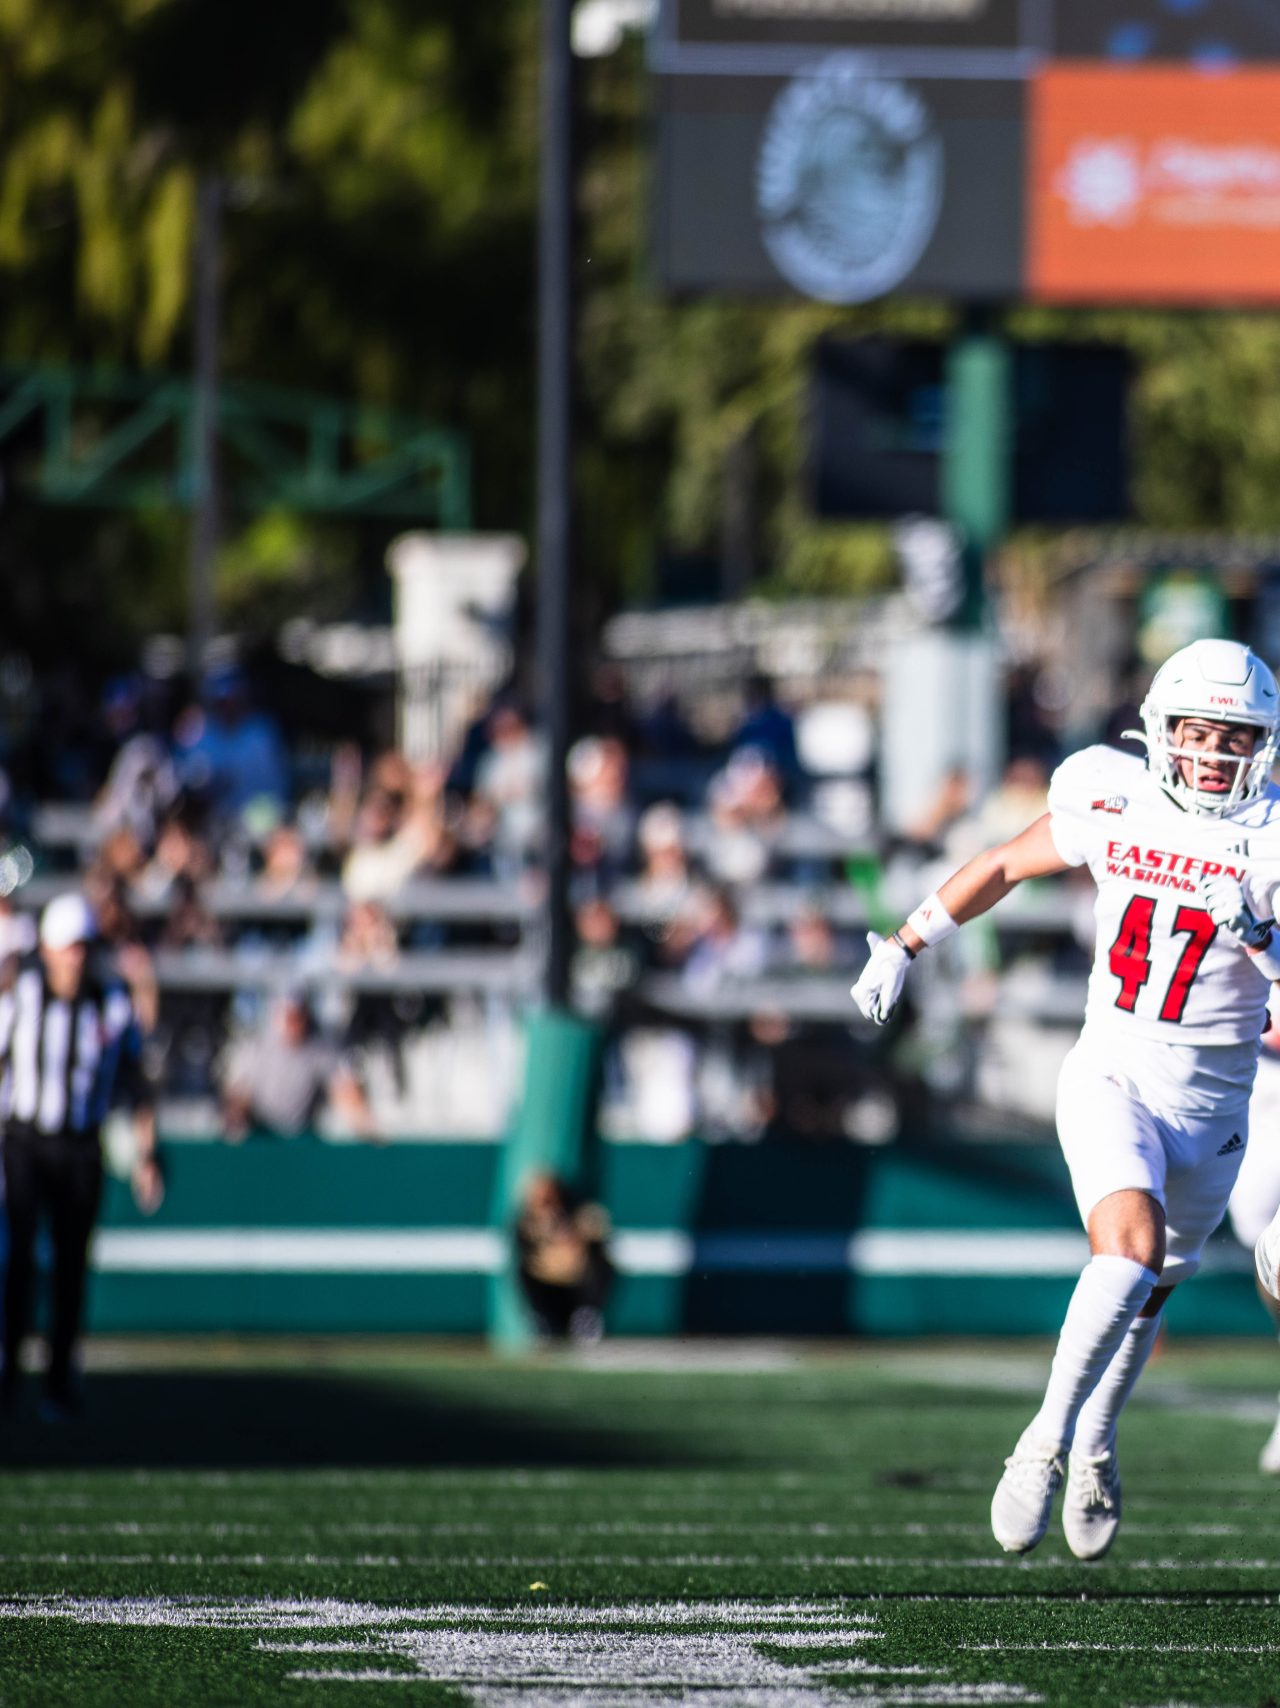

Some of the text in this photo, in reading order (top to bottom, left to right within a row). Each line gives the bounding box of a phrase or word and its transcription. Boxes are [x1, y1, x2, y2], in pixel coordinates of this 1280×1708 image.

[1105, 861, 1198, 893] WASHING
[1106, 840, 1247, 884] EASTERN
[1108, 893, 1220, 1023] 47
